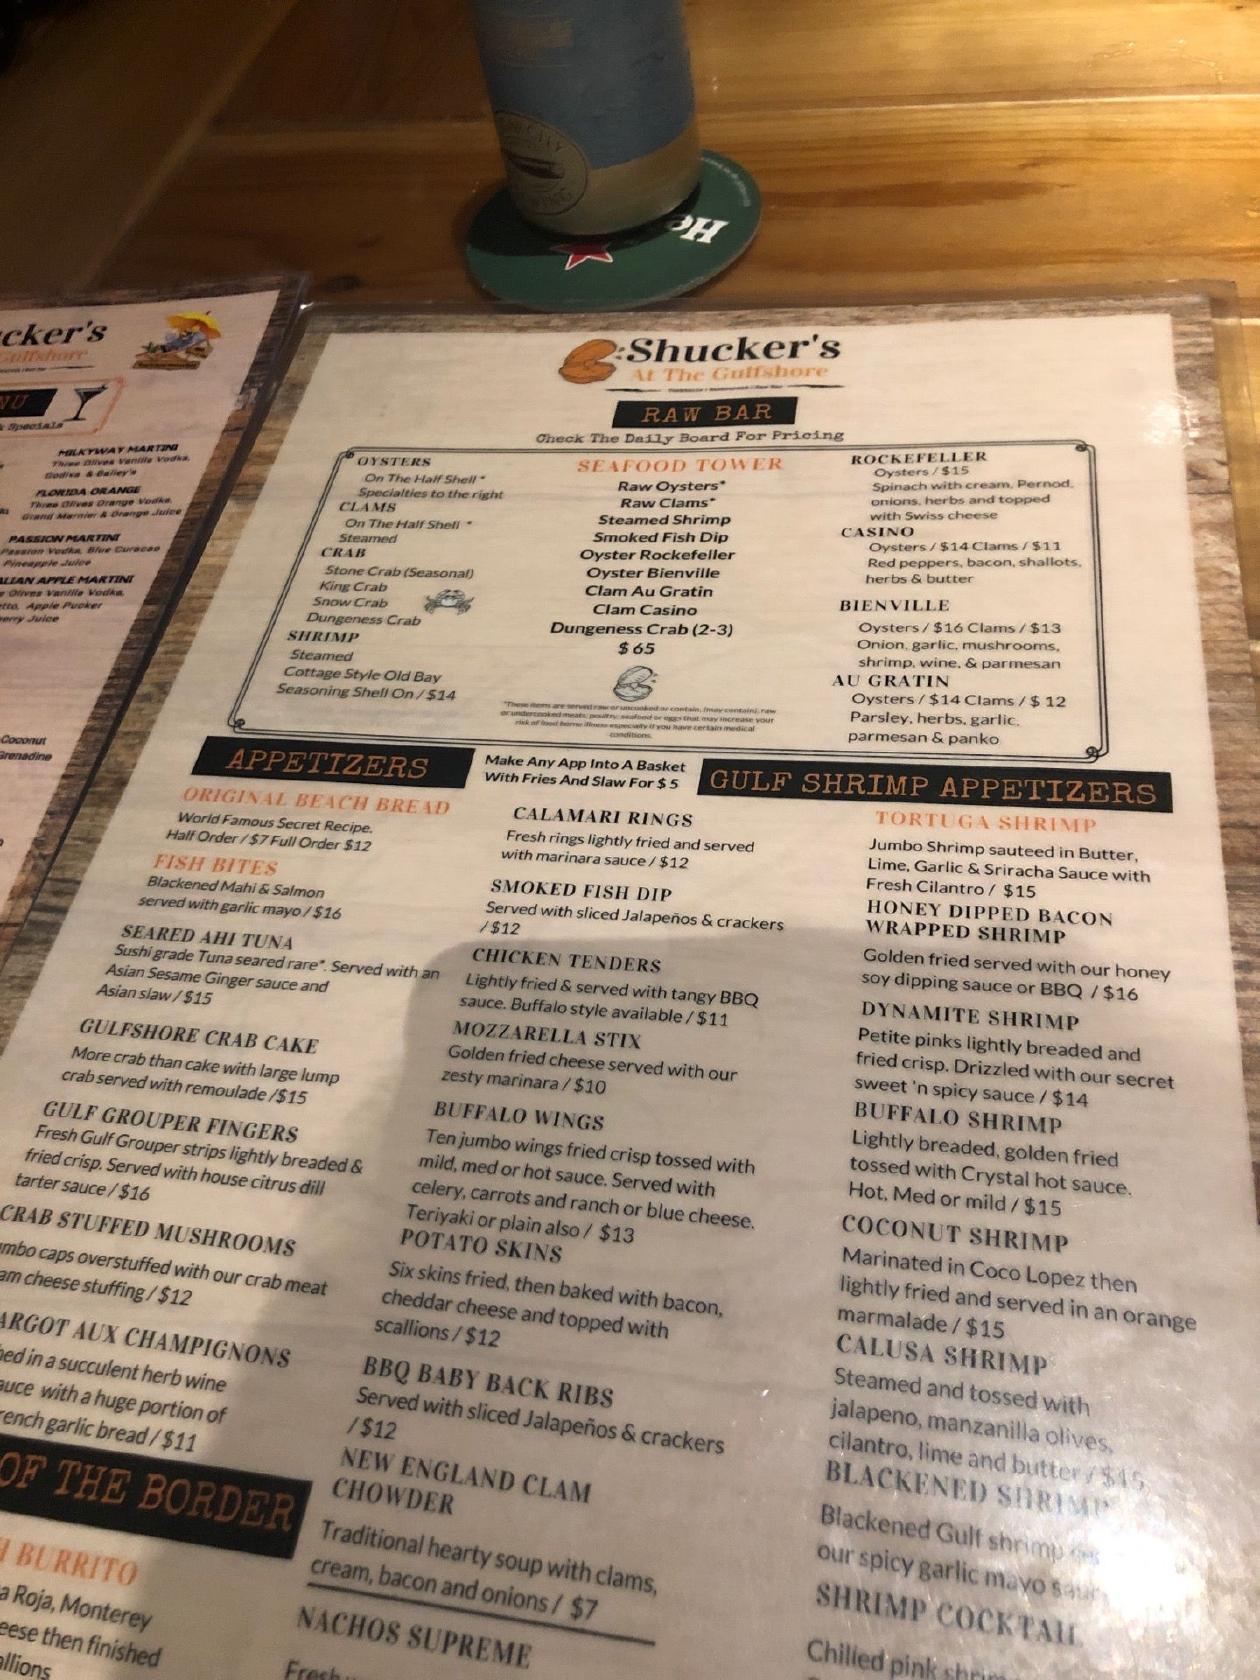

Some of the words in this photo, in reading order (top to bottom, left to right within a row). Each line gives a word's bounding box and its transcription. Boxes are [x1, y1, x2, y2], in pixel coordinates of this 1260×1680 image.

[626, 334, 842, 363] Shucker's
[640, 406, 701, 423] RAW
[713, 403, 771, 421] BAR
[535, 433, 585, 443] Check
[589, 432, 619, 443] The
[623, 432, 675, 445] Daily
[678, 431, 729, 443] Board
[734, 430, 767, 441] For
[771, 429, 844, 442] Pricing
[126, 443, 179, 453] MARTINI
[357, 456, 431, 466] OYSTERS
[577, 458, 687, 472] SEAFOOD
[695, 457, 781, 472] TOWER
[850, 451, 986, 464] ROCKEFELLER
[363, 472, 384, 483] On
[387, 472, 411, 484] The
[413, 473, 443, 484] Half
[443, 474, 477, 484] Shell
[872, 467, 929, 479] Oysters
[931, 466, 939, 476] /
[941, 465, 969, 476] $15
[35, 487, 89, 497] FLORIDA
[617, 480, 653, 491] Raw
[338, 501, 396, 512] CLAMS
[619, 497, 656, 508] Raw
[597, 514, 669, 525] Steamed
[671, 514, 731, 527] Shrimp
[64, 532, 121, 543] MARTINI
[592, 531, 659, 542] Smoked
[661, 531, 695, 542] Fish
[699, 531, 728, 544] Dip
[840, 526, 914, 537] CASINO
[320, 547, 366, 558] CRAB
[579, 549, 636, 562] Oyster
[639, 548, 736, 560] Rockefeller
[76, 574, 135, 584] MARTINI
[324, 564, 365, 576] Stone
[365, 565, 402, 577] Crab
[402, 566, 474, 580] (Seasonal)
[586, 567, 644, 579] Oyster
[646, 567, 720, 578] Bienville
[865, 573, 907, 584] herbs
[910, 573, 922, 584] &
[926, 573, 974, 584] butter
[318, 580, 351, 593] King
[352, 581, 388, 592] Crab
[584, 584, 627, 596] Clam
[630, 585, 655, 597] Au
[658, 585, 713, 597] Gratin
[311, 596, 352, 607] Snow
[352, 597, 388, 608] Crab
[839, 599, 949, 611] BIENVILLE
[592, 603, 635, 615] Clam
[639, 604, 697, 616] Casino
[305, 611, 385, 626] Dungeness
[384, 614, 421, 626] Crab
[549, 621, 642, 636] Dungeness
[646, 623, 688, 635] Crab
[691, 623, 732, 637] (2-3)
[858, 622, 919, 635] Oysters
[921, 622, 930, 635] /
[932, 621, 965, 635] $16
[967, 622, 1016, 634] Clams
[1018, 623, 1027, 634] /
[1029, 622, 1062, 635] $13
[286, 630, 359, 643] SHRIMP
[617, 640, 629, 655] $
[632, 642, 655, 654] 65
[832, 674, 859, 687] AU
[868, 674, 948, 687] GRATIN
[224, 748, 428, 779] APPETIZERS
[484, 754, 524, 766] Make
[525, 756, 556, 769] Any
[556, 757, 586, 771] App
[590, 758, 619, 769] Into
[620, 759, 633, 770] A
[635, 759, 686, 772] Basket
[710, 769, 792, 791] GULF
[801, 772, 928, 796] SHRIMP
[938, 776, 1156, 804] APPETIZERS
[183, 786, 286, 806] ORIGINAL
[294, 792, 369, 810] BEACH
[374, 796, 450, 815] BREAD
[513, 806, 620, 823] CALAMARI
[627, 811, 692, 827] RINGS
[875, 810, 991, 829] TORTUGA
[997, 815, 1096, 833] SHRIMP
[152, 853, 206, 871] FISH
[210, 856, 278, 876] BITES
[120, 924, 195, 942] SEARED
[198, 930, 236, 946] AHI
[241, 933, 292, 950] TUNA
[861, 1000, 979, 1024] DYNAMITE
[988, 1009, 1079, 1030] SHRIMP
[79, 1018, 200, 1043] GULFSHORE
[204, 1029, 258, 1048] CRAB
[263, 1034, 319, 1054] CAKE
[42, 1100, 98, 1120] GULF
[100, 1106, 200, 1132] GROUPER
[205, 1117, 298, 1143] FINGERS
[433, 1100, 527, 1124] BUFFALO
[535, 1109, 604, 1131] WINGS
[836, 1333, 934, 1363] CALUSA
[943, 1345, 1047, 1376] SHRIMP
[361, 1355, 410, 1385] BBQ
[416, 1362, 479, 1389] BABY
[485, 1372, 549, 1400] BACK
[556, 1381, 613, 1408] RIBS
[340, 1446, 392, 1472] NEW
[399, 1455, 515, 1491] ENGLAND
[521, 1473, 591, 1503] CLAM
[0, 1451, 48, 1489] OF
[52, 1458, 131, 1504] THE
[136, 1472, 295, 1532] BORDER
[15, 1542, 143, 1586] BURRITO
